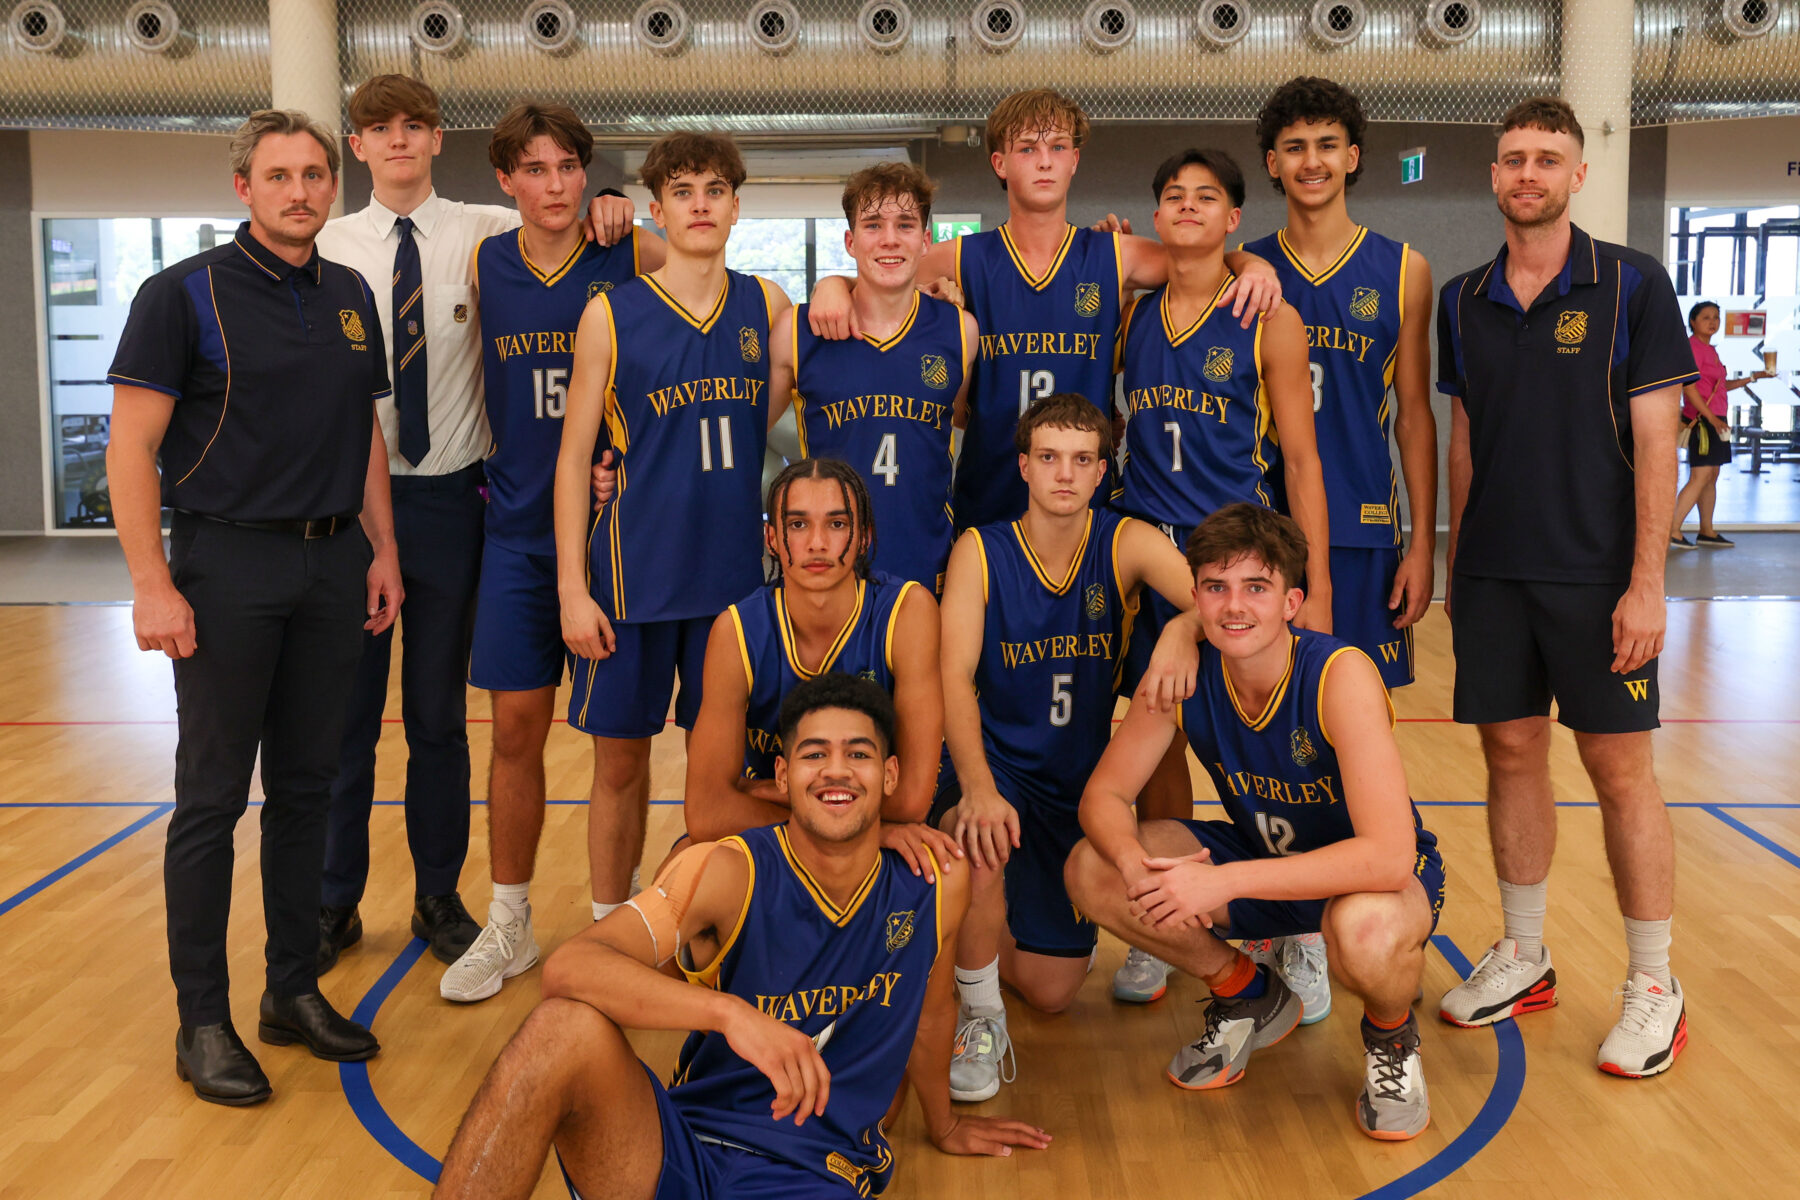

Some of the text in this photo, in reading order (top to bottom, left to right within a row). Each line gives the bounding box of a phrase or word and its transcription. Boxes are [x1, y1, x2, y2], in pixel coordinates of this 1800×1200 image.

[979, 332, 1101, 361] WAVERLEY
[1556, 346, 1581, 354] STAFF
[532, 367, 568, 419] 15
[820, 394, 948, 430] WAVERLEY
[1129, 384, 1232, 424] WAVERLEY
[699, 415, 735, 472] 11
[871, 432, 900, 487] 4
[1163, 421, 1183, 472] 7
[1000, 632, 1113, 670] WAVERLEY
[1377, 640, 1401, 664] W
[1050, 673, 1073, 727] 5
[1623, 678, 1649, 702] W
[1254, 811, 1303, 858] 12
